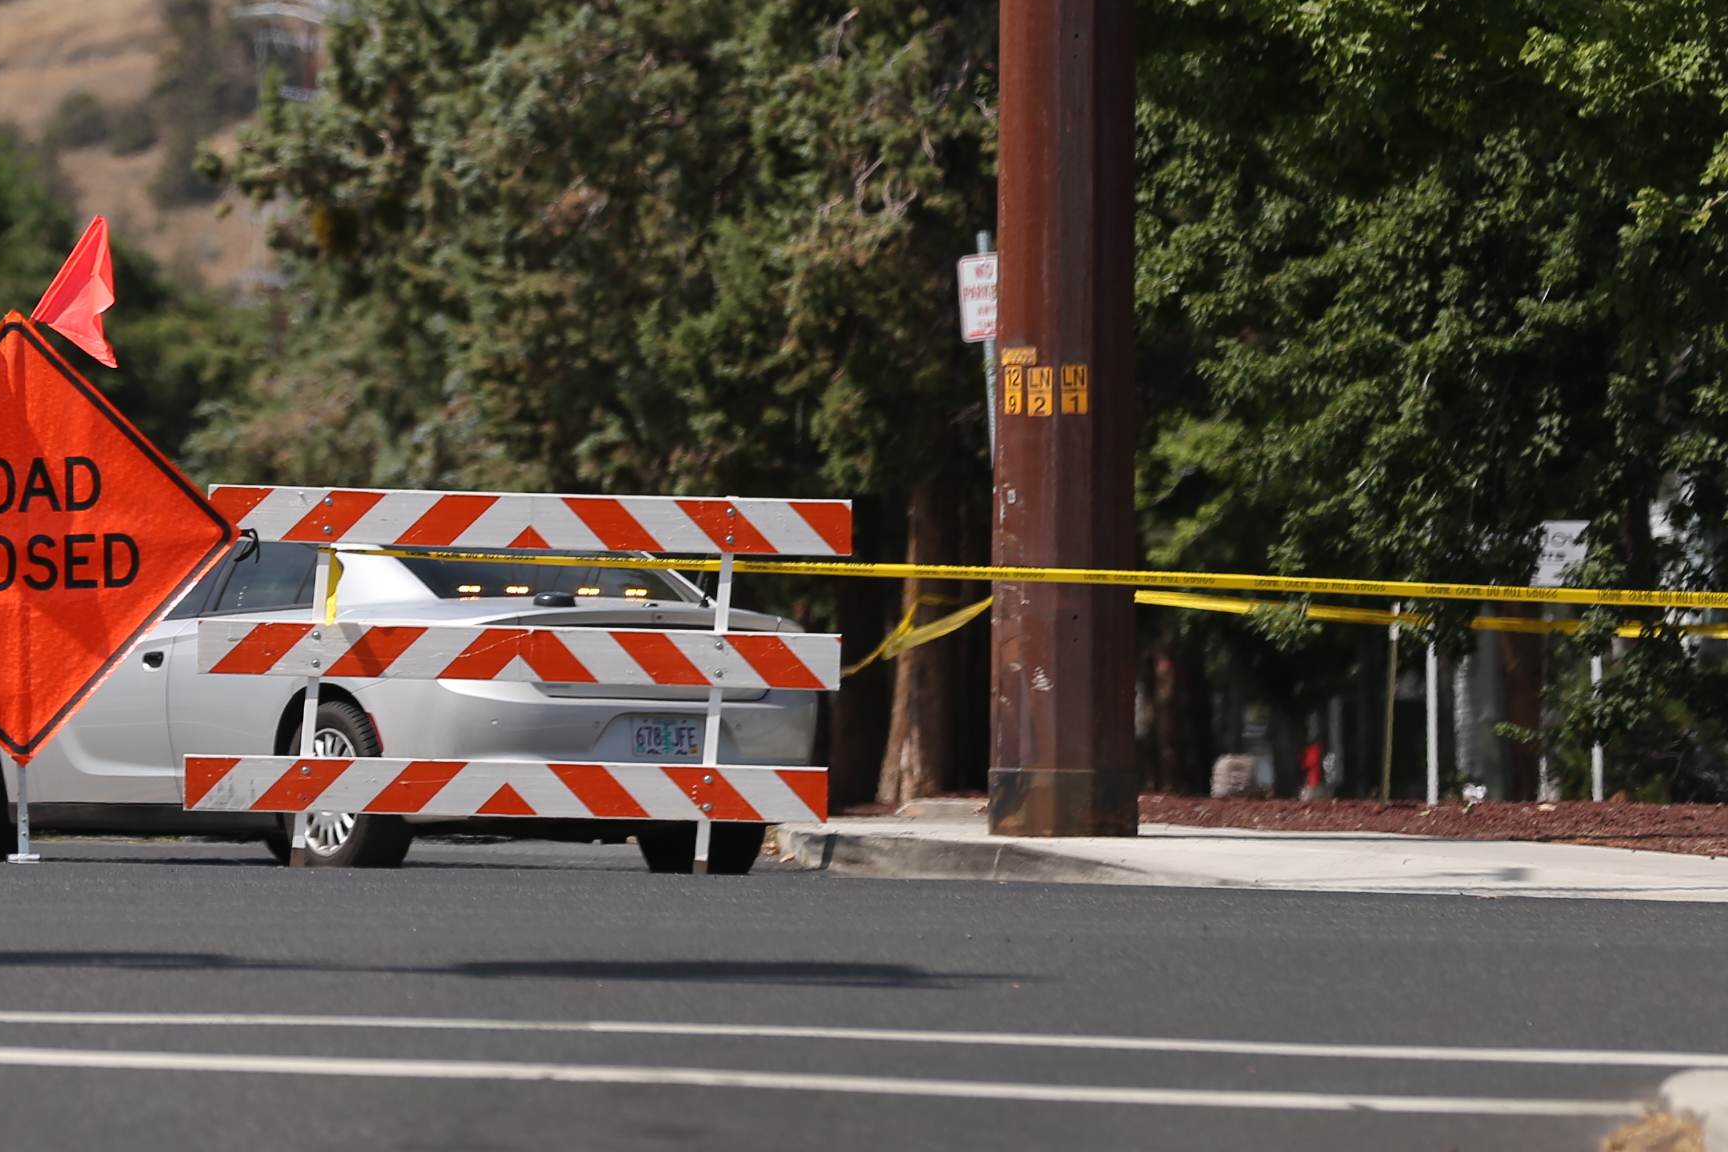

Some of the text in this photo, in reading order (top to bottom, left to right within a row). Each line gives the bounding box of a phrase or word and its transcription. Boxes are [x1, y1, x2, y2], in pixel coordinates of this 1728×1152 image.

[1006, 369, 1020, 387] 12
[1030, 369, 1050, 388] LN
[1063, 367, 1085, 386] LN
[1008, 395, 1017, 413] 9
[1034, 397, 1046, 414] 2
[1070, 395, 1079, 412] 1
[636, 726, 661, 747] 678
